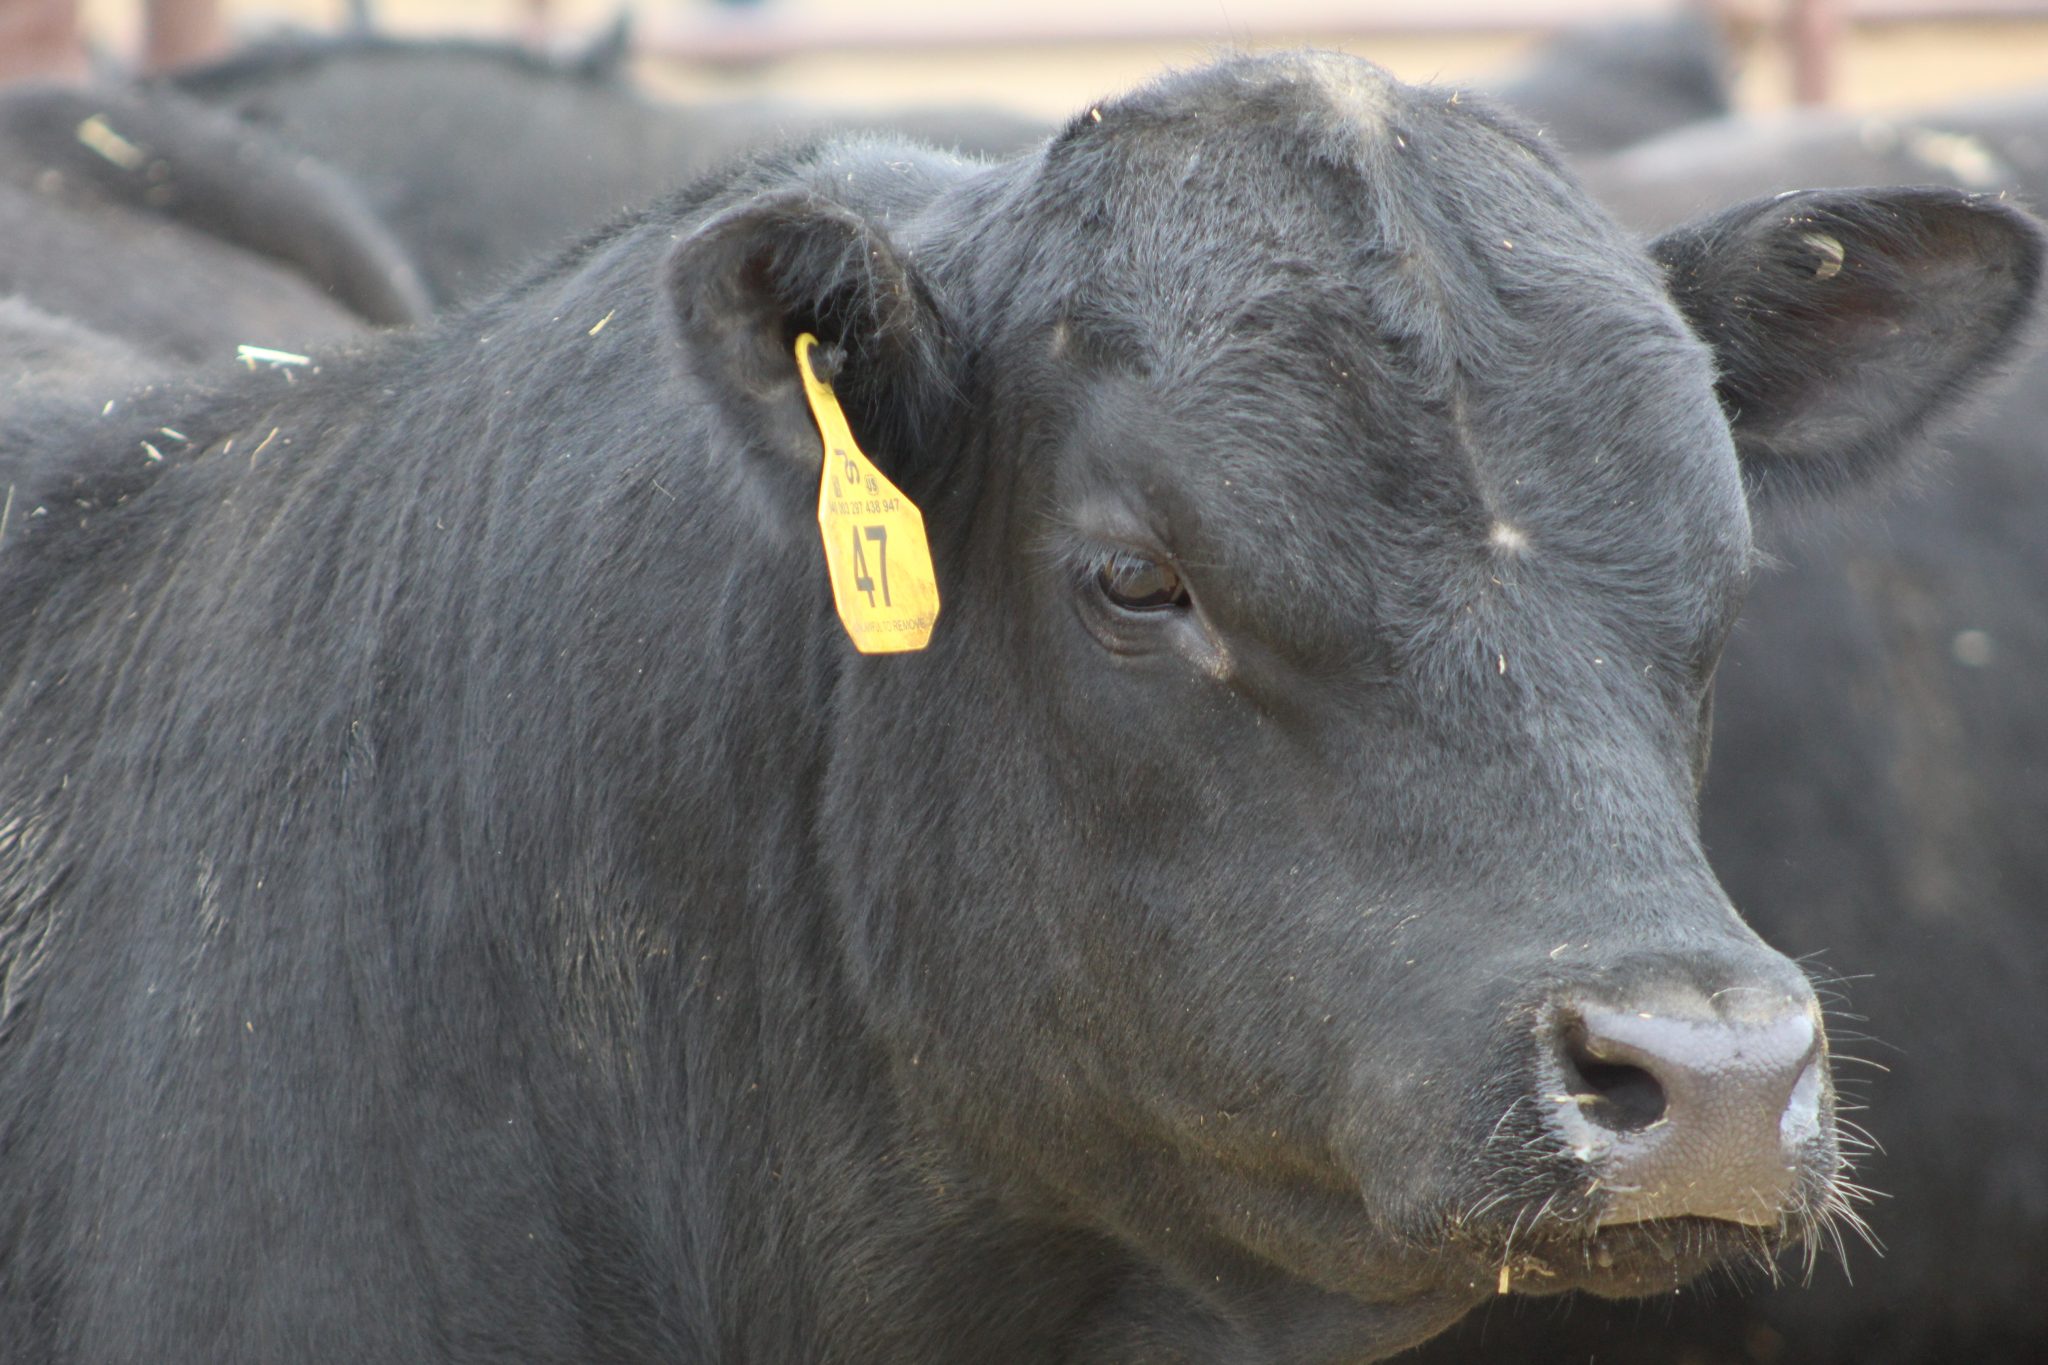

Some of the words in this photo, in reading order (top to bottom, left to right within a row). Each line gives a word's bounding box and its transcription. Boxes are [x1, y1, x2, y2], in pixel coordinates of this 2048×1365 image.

[865, 500, 881, 514] 438
[882, 498, 900, 512] 947
[852, 525, 891, 608] 47
[892, 617, 926, 632] REMOVE
